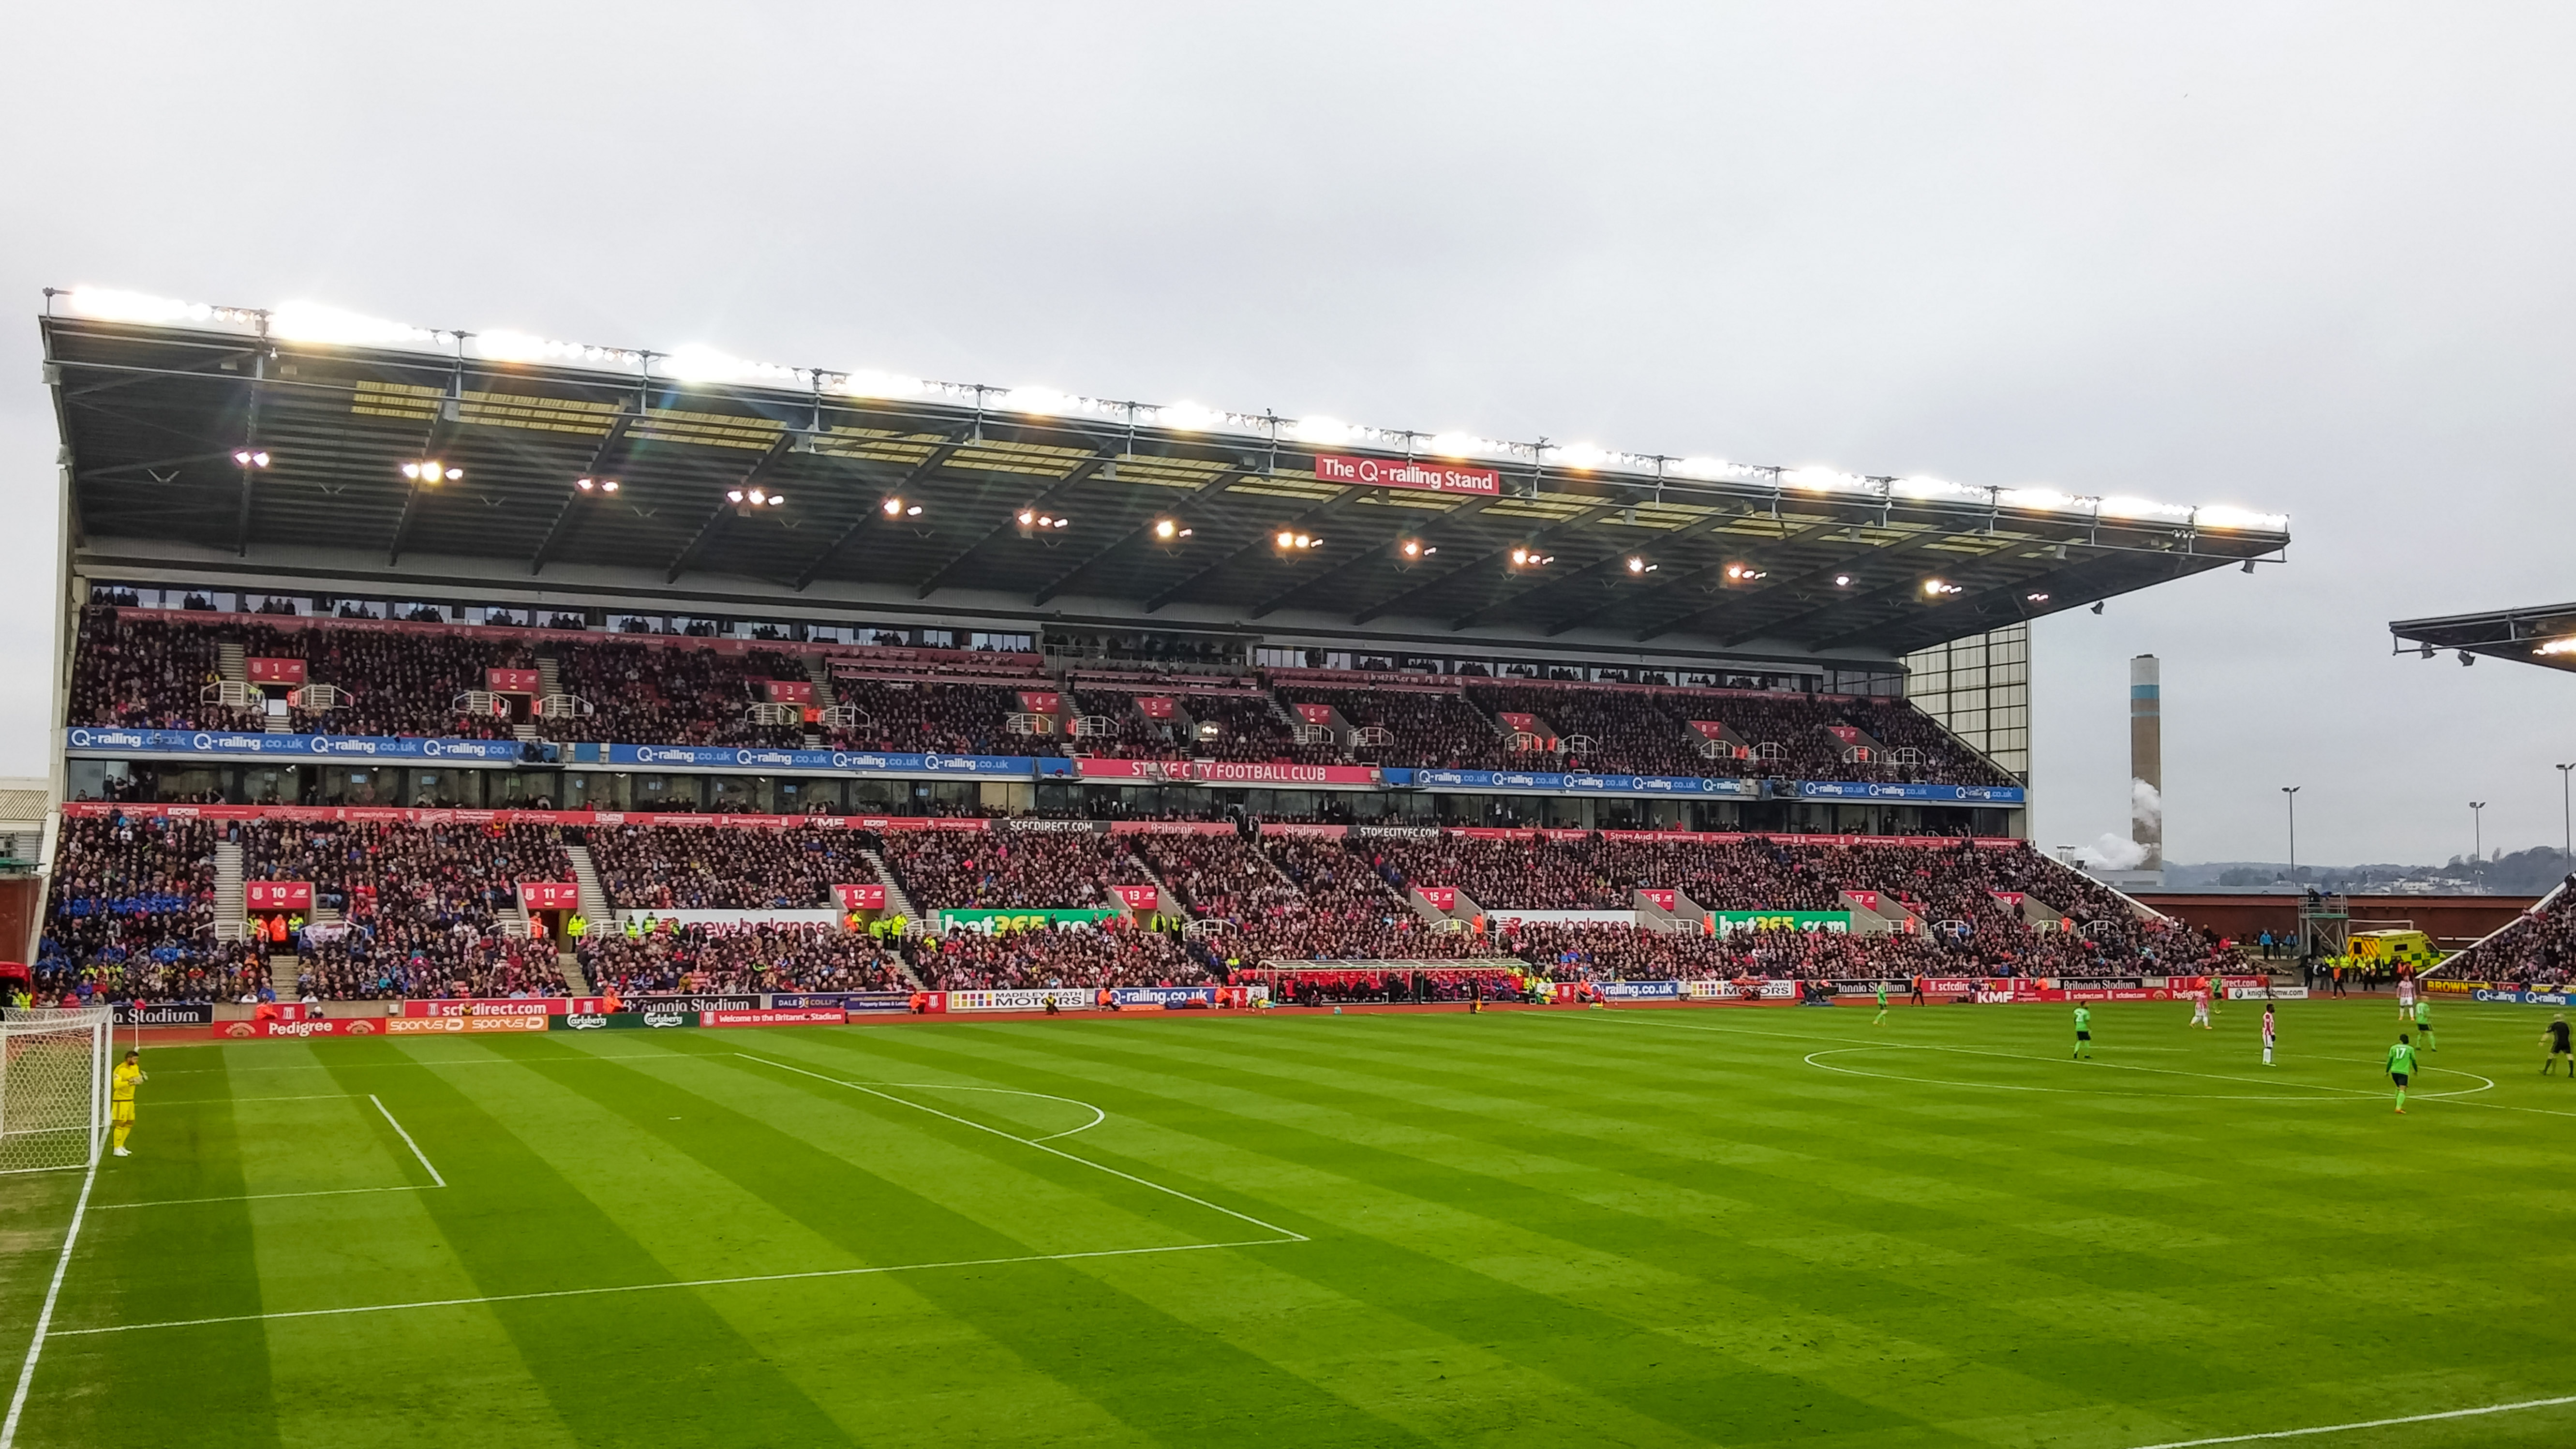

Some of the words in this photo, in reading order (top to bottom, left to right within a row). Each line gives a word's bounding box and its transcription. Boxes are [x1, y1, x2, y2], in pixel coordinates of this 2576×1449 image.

[1323, 459, 1354, 478] The
[1359, 460, 1441, 489] Q-railing
[1445, 471, 1492, 490] Stand
[274, 662, 279, 672] 1
[509, 673, 517, 683] 2
[787, 685, 793, 694] 3
[1036, 696, 1042, 705] 4
[1152, 701, 1157, 710] 5
[1513, 716, 1519, 724] 7
[194, 733, 303, 750] Q-railing.co.uk
[311, 736, 416, 754] Q-railing.co.uk
[637, 747, 730, 762] Q-railing.co.uk
[736, 750, 826, 765] Q-railing.co.uk
[833, 752, 919, 768] Q-railing.co.uk
[925, 755, 1008, 770] Q-railing.co.uk
[1132, 762, 1181, 777] STKE
[1218, 764, 1286, 779] FOOTBALL
[1292, 766, 1326, 781] CLUB
[1419, 770, 1488, 784] Q-railing.co.uk
[1492, 773, 1559, 786] Q-railing.co.uk
[1563, 775, 1628, 788] Q-railing.co.uk
[1632, 777, 1696, 791] Q-railing.co.uk
[1805, 782, 1865, 795] Q-railing.co.uk
[1868, 784, 1927, 797] Q-railing.co.uk
[271, 887, 286, 898] 10
[543, 887, 555, 899] 11
[853, 890, 865, 900] 12
[1129, 891, 1140, 900] 13
[1429, 892, 1439, 901] 15
[1651, 893, 1660, 902] 16
[1856, 894, 1863, 903] 17
[2064, 980, 2100, 990] Britannia
[2102, 979, 2136, 989] Stadium
[2427, 980, 2468, 992] BROWN
[1977, 991, 2014, 1003] KMF
[2525, 991, 2566, 1005] Q-railing
[442, 1003, 546, 1016] scfdirect.com
[691, 998, 749, 1012] Stadium
[128, 1008, 199, 1023] Stadium
[567, 1013, 607, 1028] Carlsberg
[644, 1012, 683, 1027] Carlsberg
[810, 1012, 841, 1021] Stadium
[269, 1022, 332, 1037] Pedigree
[2396, 1047, 2406, 1059] 17
